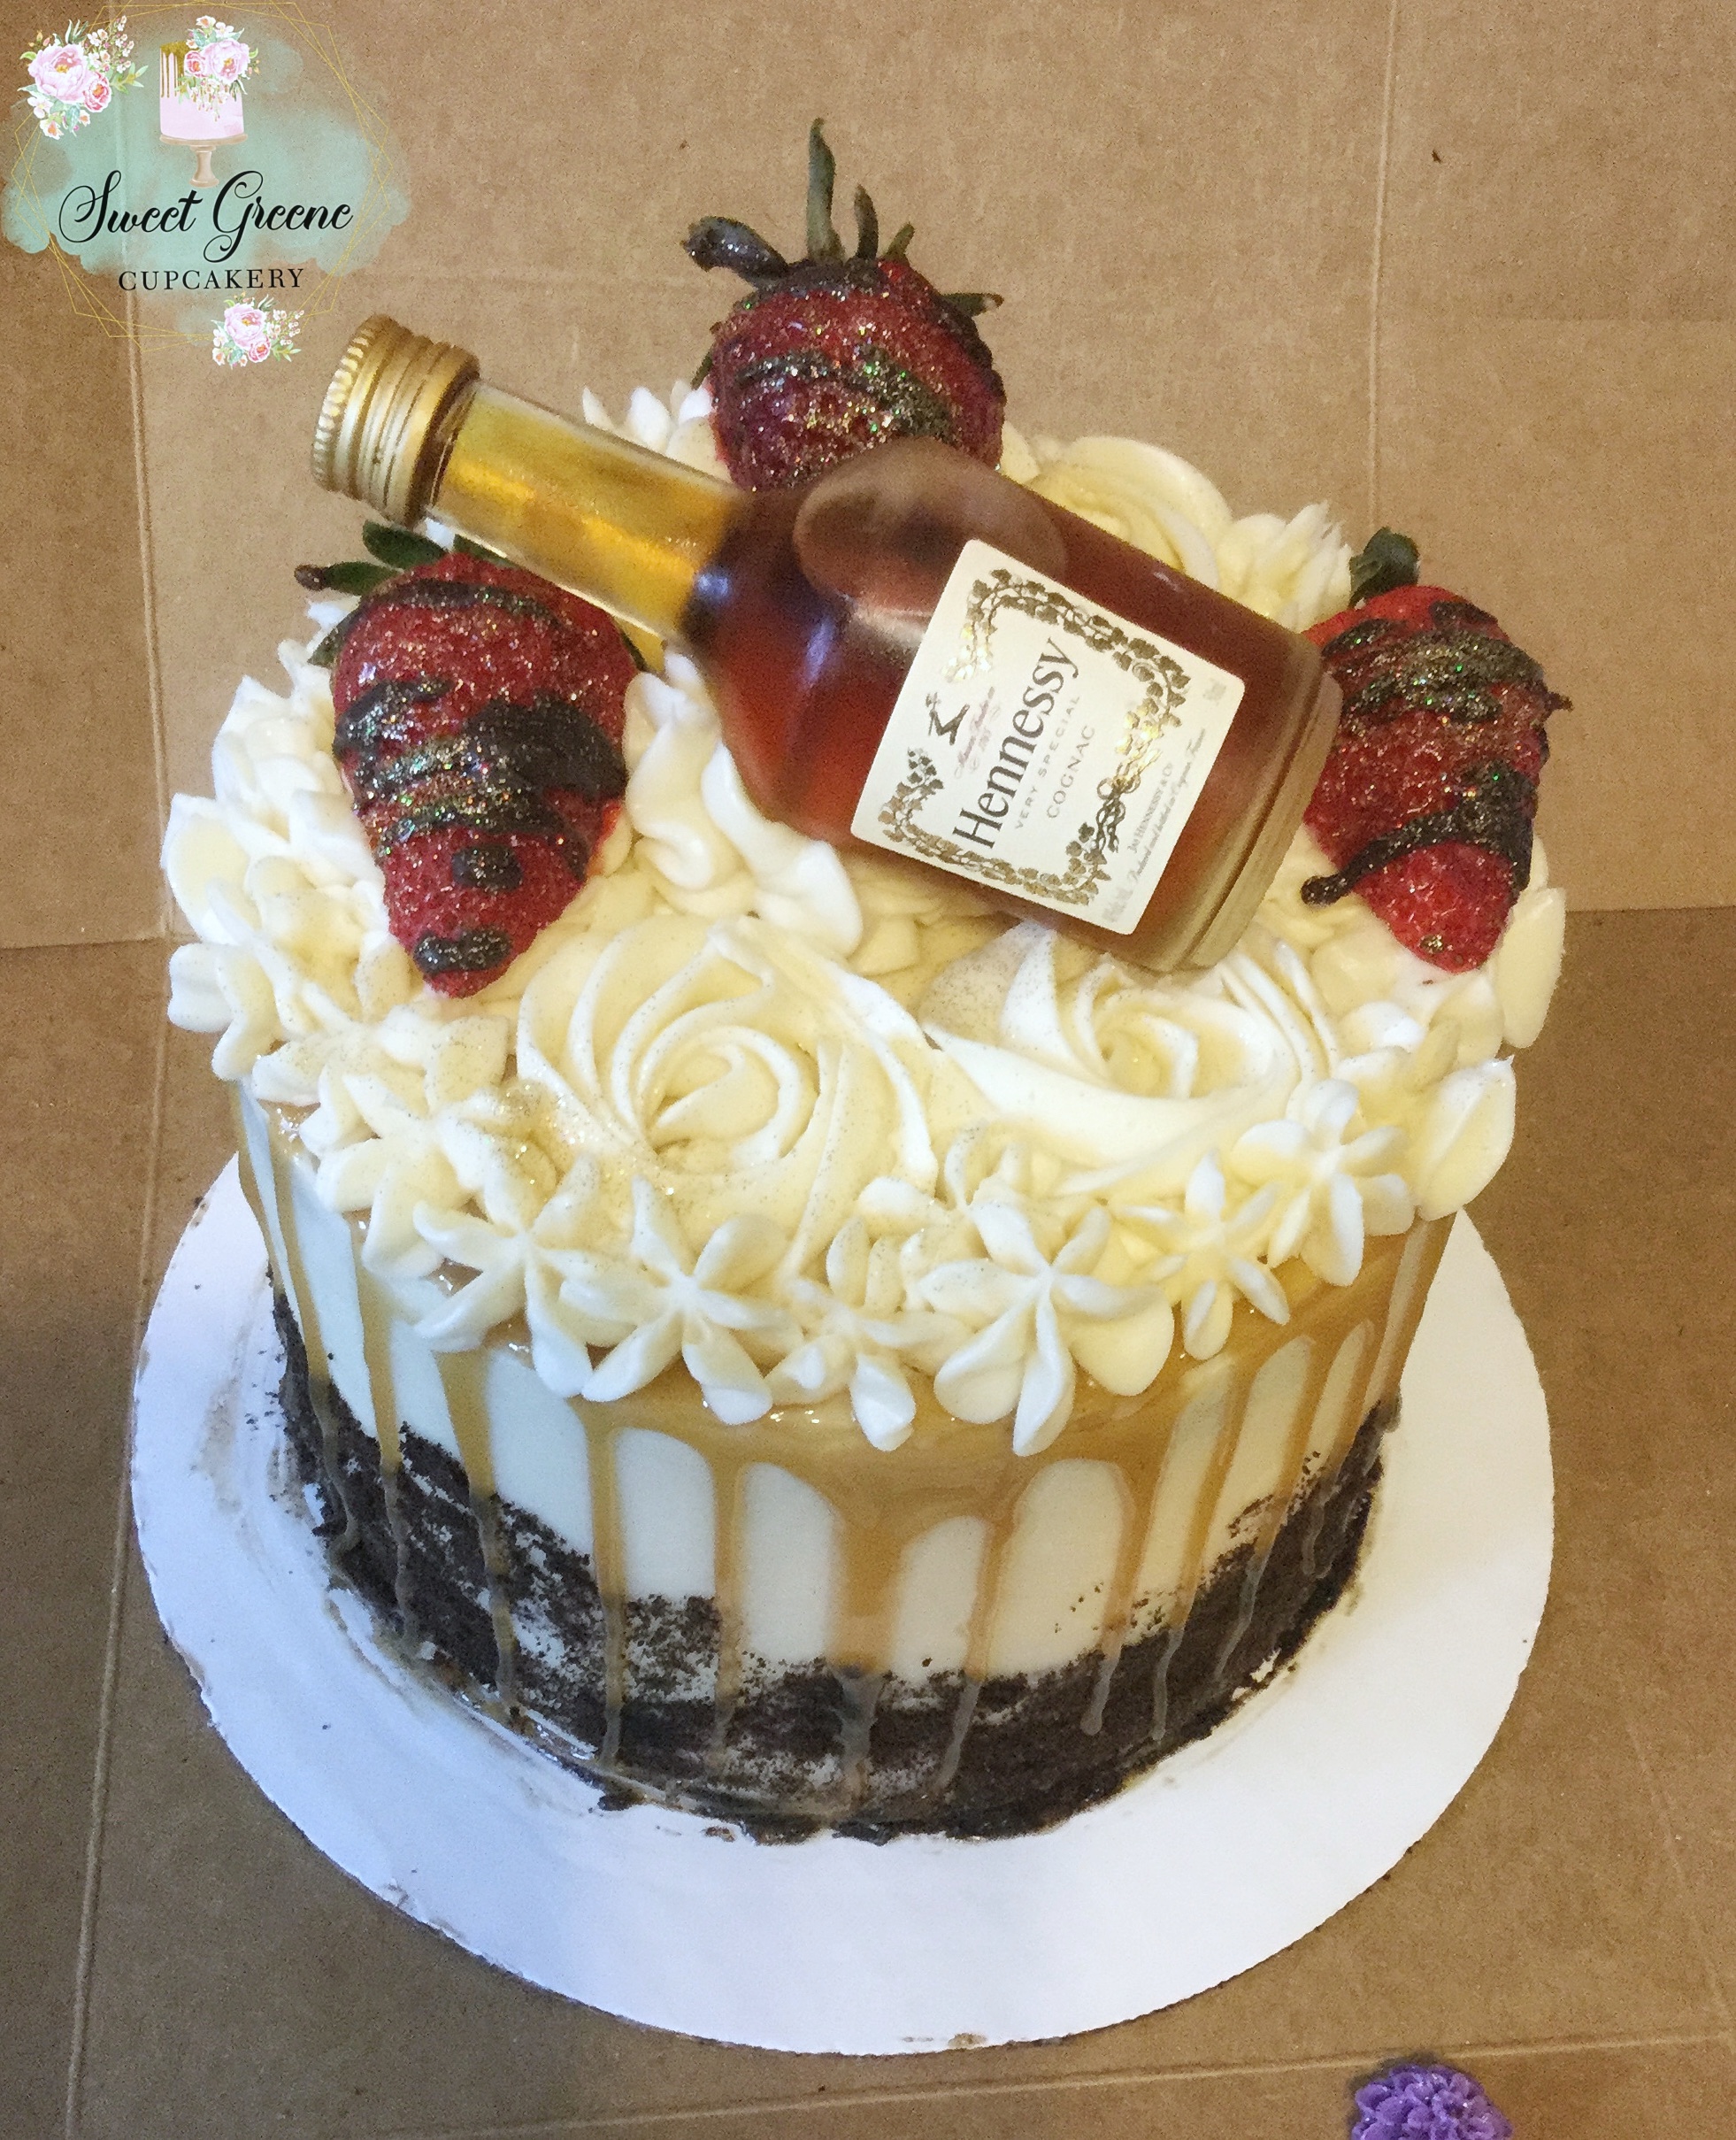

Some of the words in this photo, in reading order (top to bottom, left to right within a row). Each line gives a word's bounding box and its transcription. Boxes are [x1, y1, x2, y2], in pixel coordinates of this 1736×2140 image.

[952, 637, 1079, 849] Hennessy
[1014, 786, 1038, 829] VERY
[1037, 696, 1080, 777] SPECIAL
[1046, 725, 1095, 819] COGNAC
